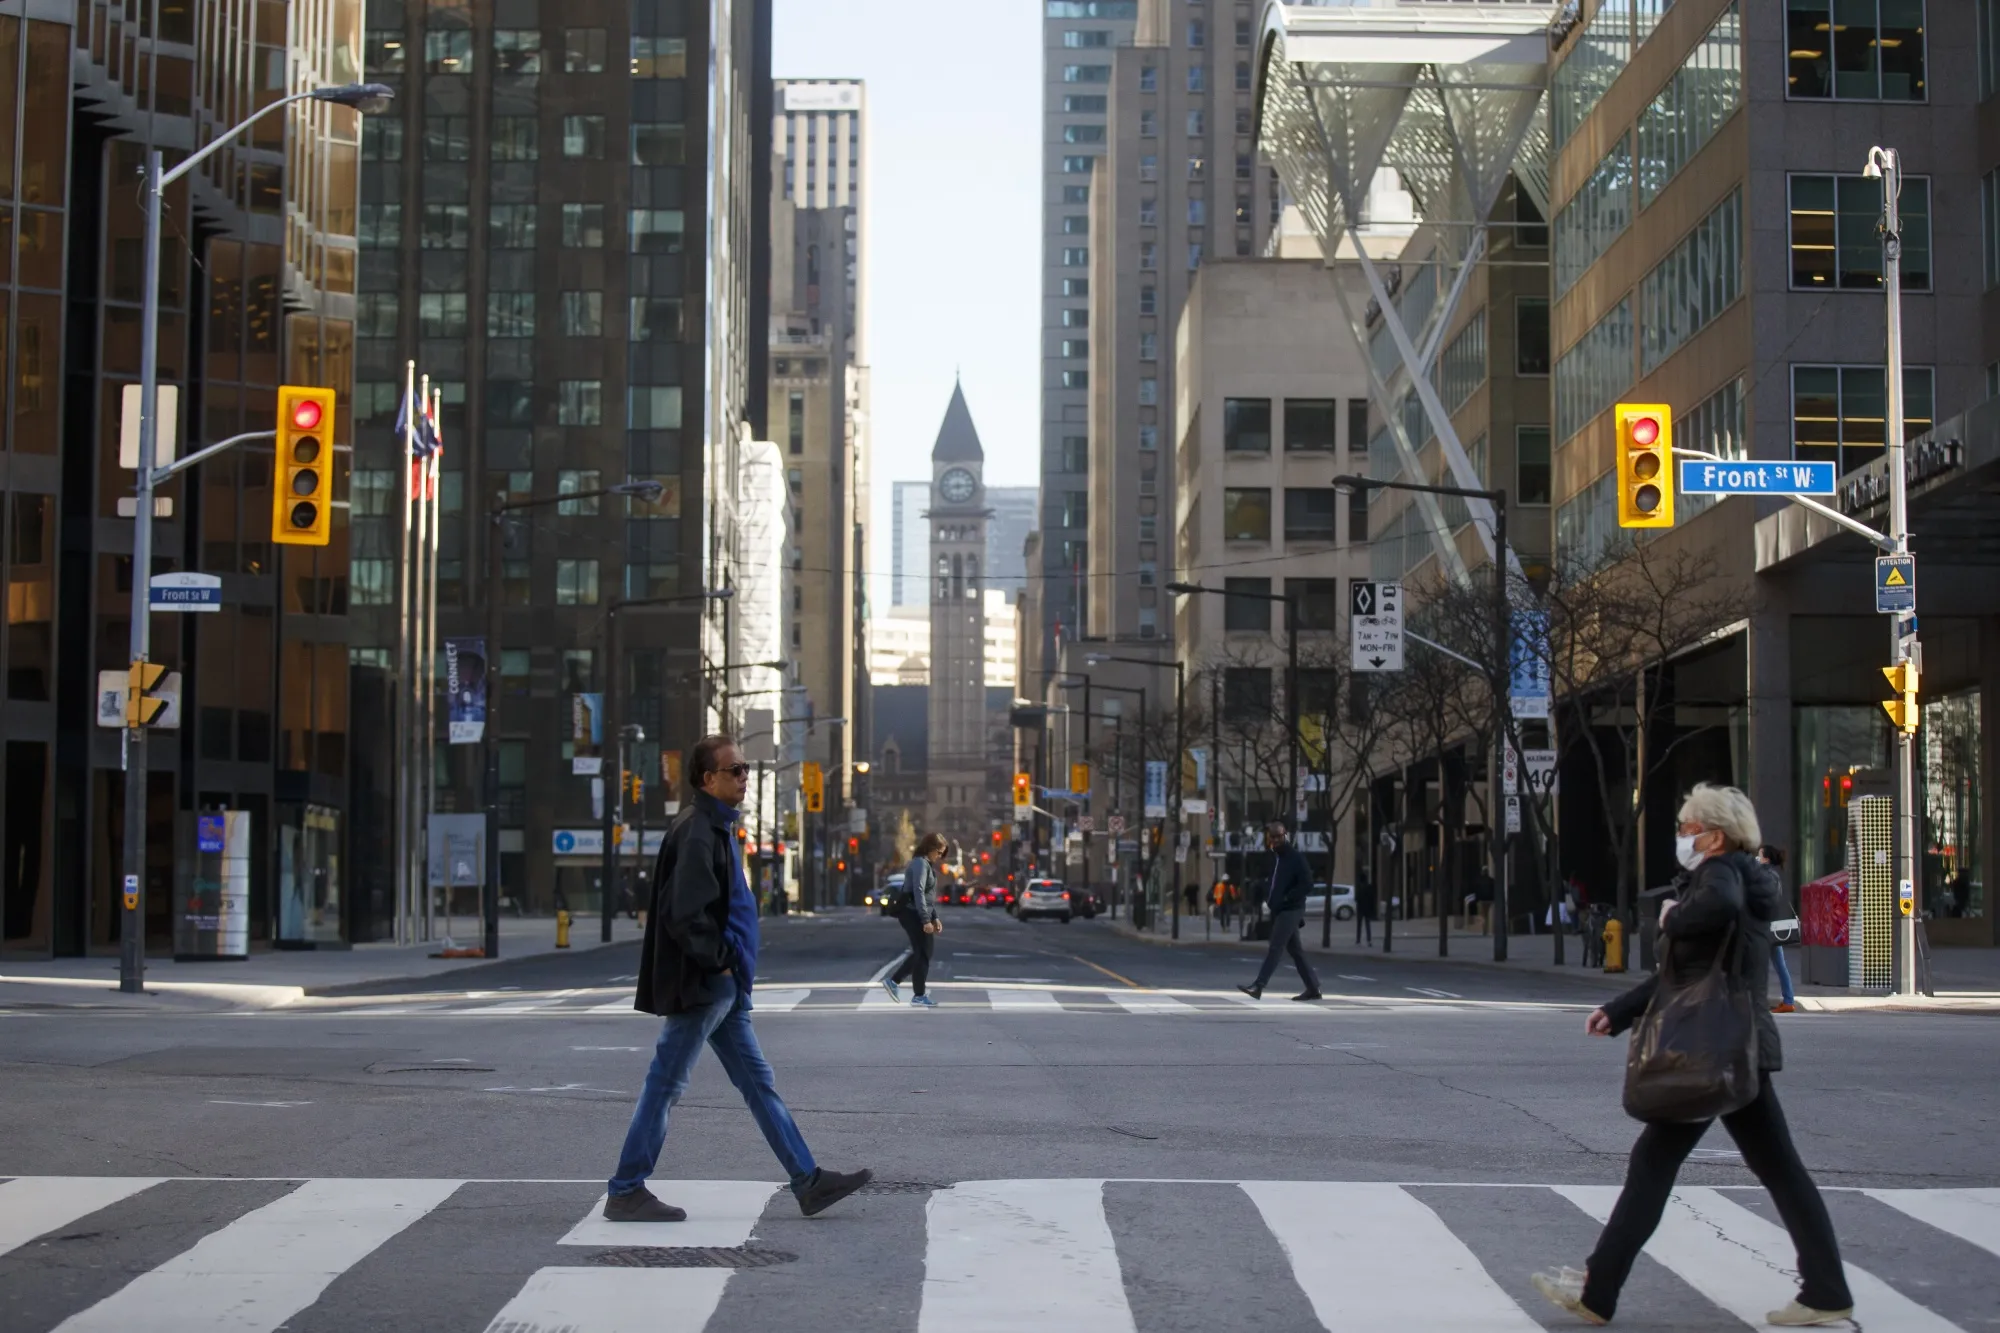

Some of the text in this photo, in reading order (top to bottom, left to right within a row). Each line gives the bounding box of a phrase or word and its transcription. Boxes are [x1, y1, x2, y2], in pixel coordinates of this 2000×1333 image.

[1704, 465, 1811, 488] Front St W
[1880, 558, 1911, 566] ATTENTION
[161, 589, 189, 600] Front
[200, 589, 211, 600] W
[1359, 643, 1396, 652] MON-FRI
[445, 642, 459, 694] CONNECT
[1529, 769, 1555, 788] 40
